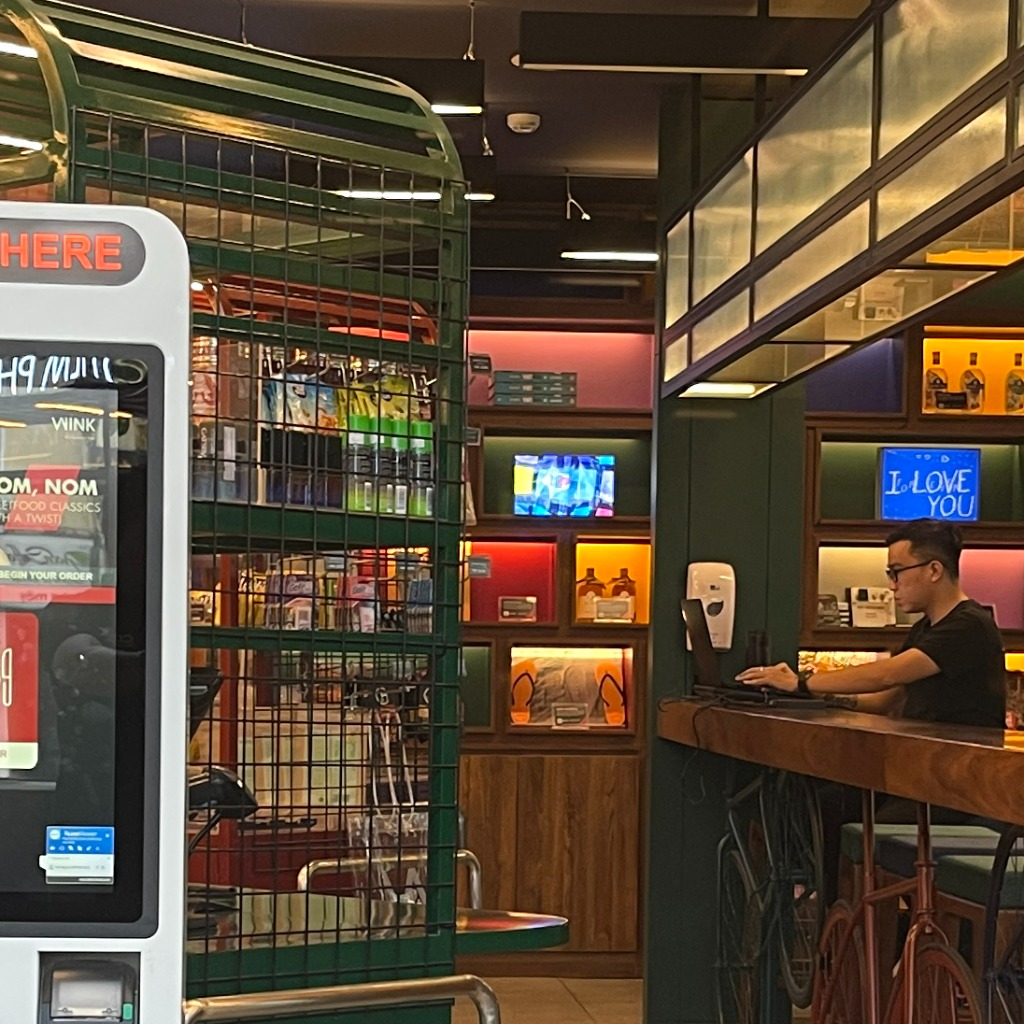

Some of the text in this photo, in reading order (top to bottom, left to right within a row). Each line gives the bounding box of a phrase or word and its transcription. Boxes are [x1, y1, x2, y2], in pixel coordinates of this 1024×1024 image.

[0, 232, 122, 270] HERE
[51, 417, 96, 432] WINK
[45, 479, 98, 496] NOM
[885, 470, 901, 494] I
[912, 469, 972, 493] LOVE
[50, 501, 101, 513] CLASSICS
[928, 494, 974, 517] YOU
[14, 513, 22, 523] A
[29, 571, 57, 580] YOUR
[59, 572, 93, 580] ORDER
